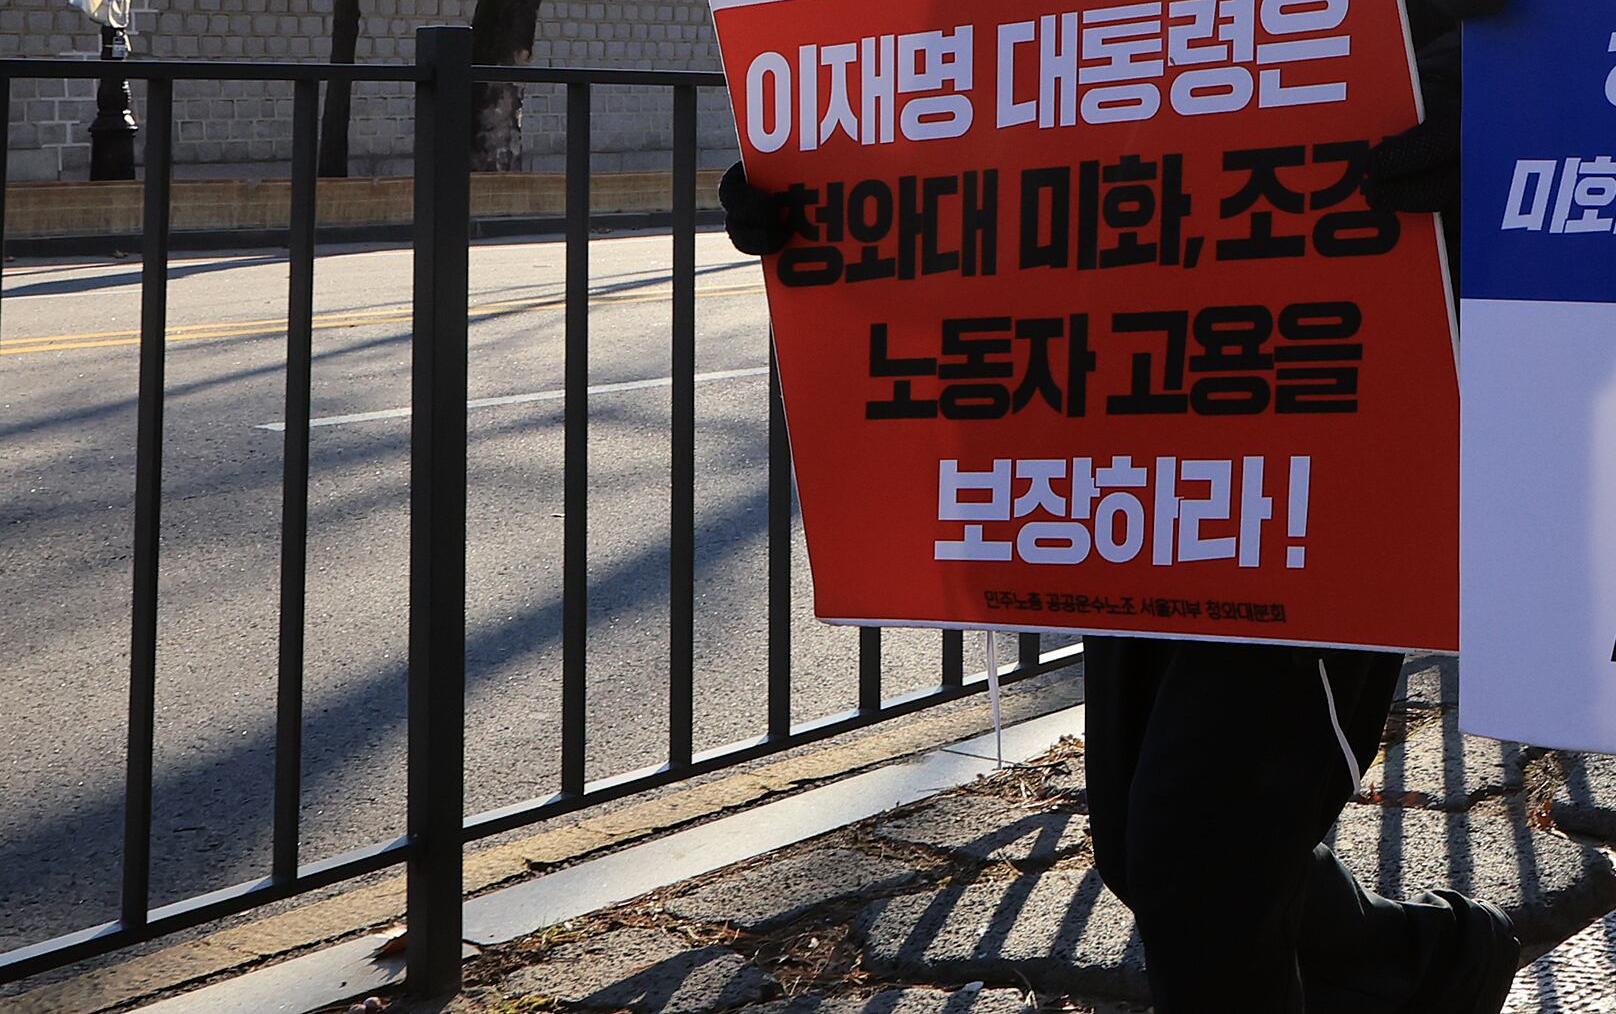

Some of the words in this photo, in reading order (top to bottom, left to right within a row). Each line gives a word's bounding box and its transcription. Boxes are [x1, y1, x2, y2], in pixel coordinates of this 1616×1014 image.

[745, 23, 973, 153] 이재명
[776, 169, 997, 286] 청와대
[1019, 154, 1204, 271] 미화,
[866, 313, 1095, 420] 노동자
[1107, 301, 1363, 416] 고용을
[984, 591, 1042, 611] 민주노총
[1046, 593, 1137, 615] 공공운수노조
[1140, 597, 1202, 619] 서울지부
[1206, 600, 1286, 623] 청와대분회
